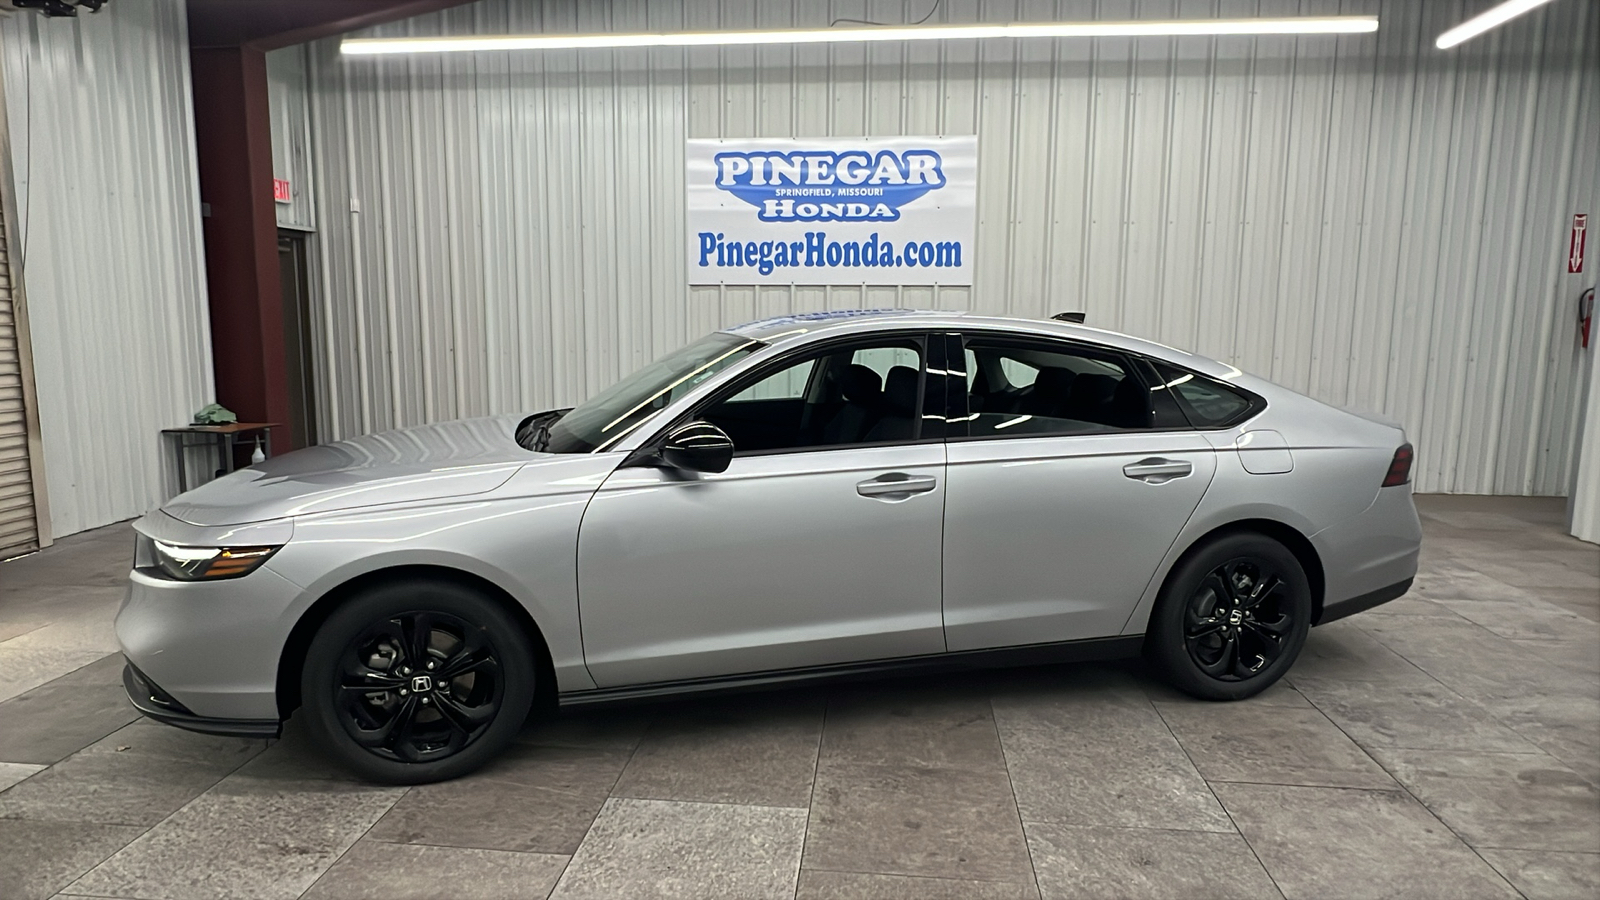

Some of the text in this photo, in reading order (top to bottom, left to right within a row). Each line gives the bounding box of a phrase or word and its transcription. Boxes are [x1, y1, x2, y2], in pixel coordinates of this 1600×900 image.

[718, 154, 942, 186] PINEGAR
[775, 187, 884, 198] SPRINGFIELD, MISSOURI
[762, 199, 896, 218] HONDA
[698, 232, 962, 276] PinegarHonda.com
